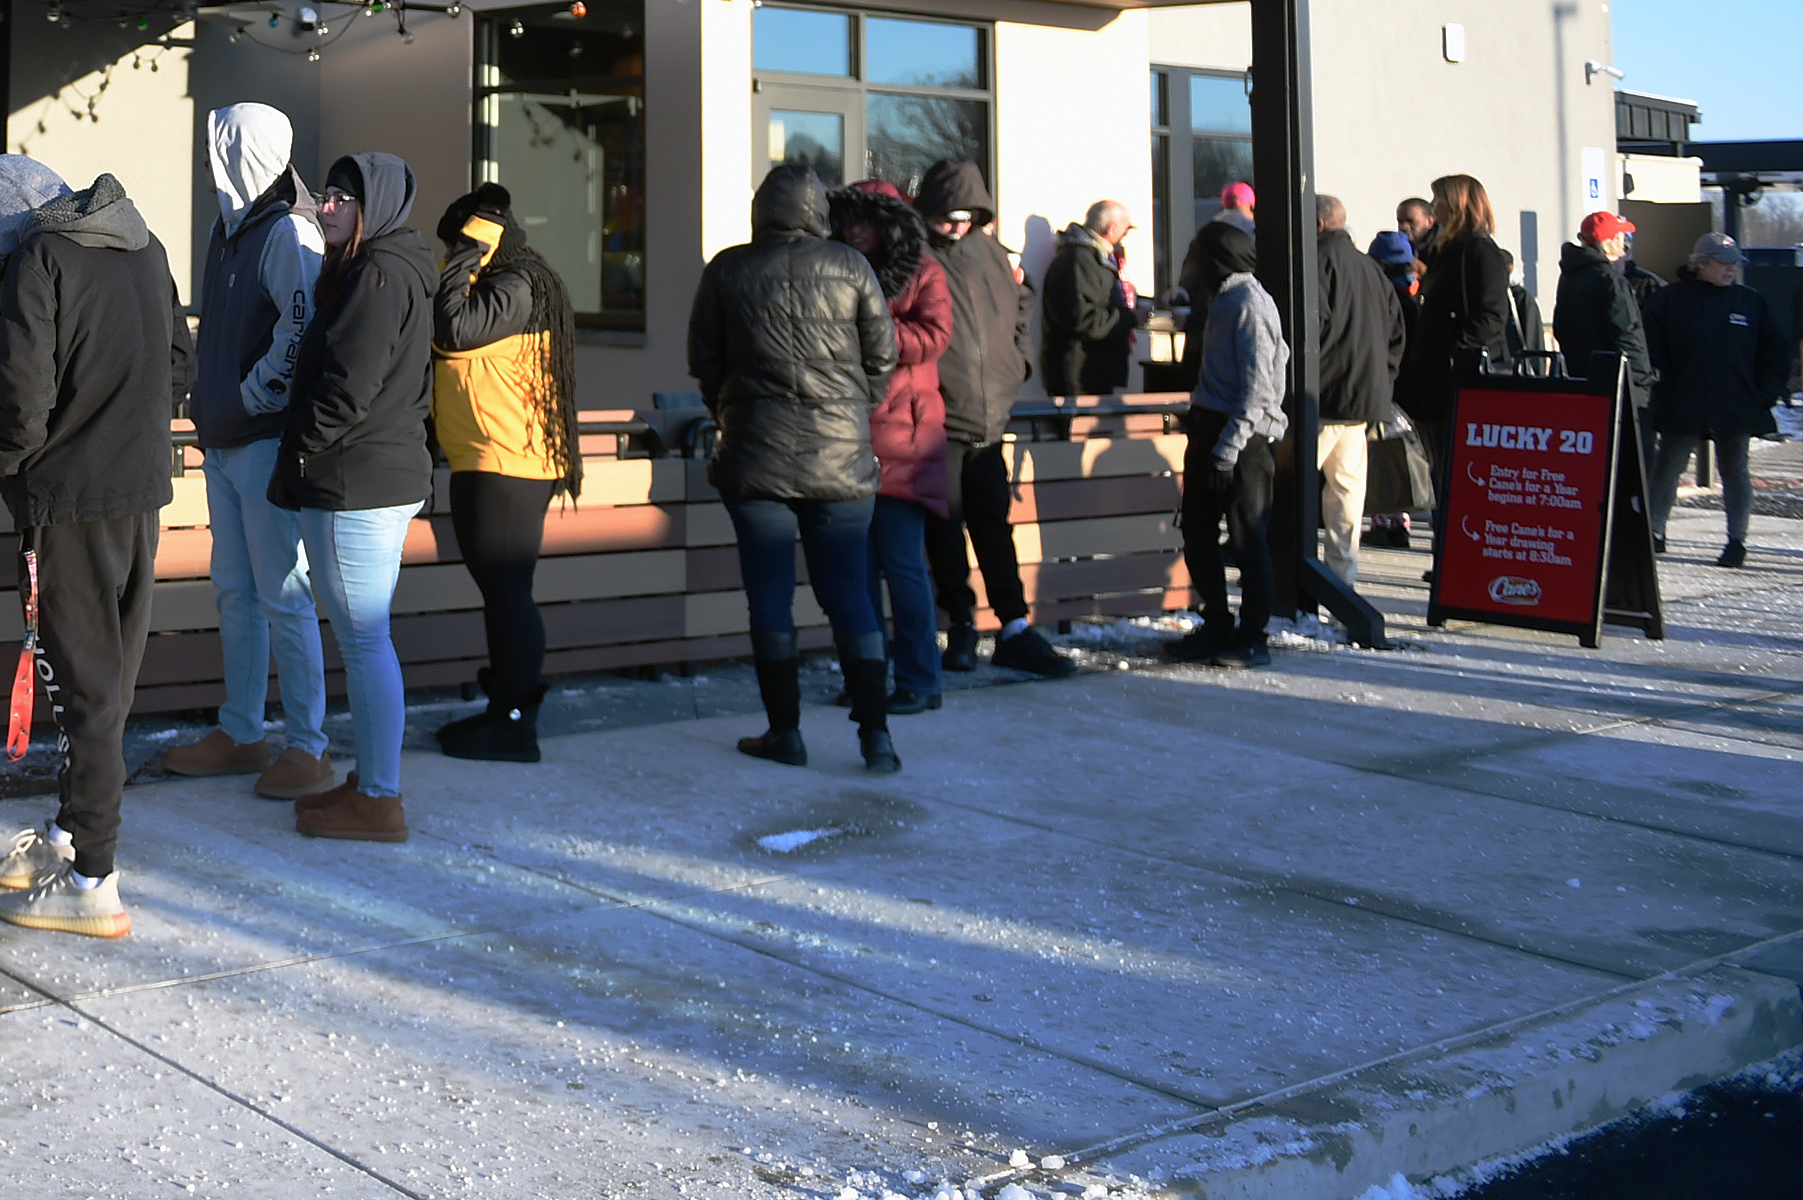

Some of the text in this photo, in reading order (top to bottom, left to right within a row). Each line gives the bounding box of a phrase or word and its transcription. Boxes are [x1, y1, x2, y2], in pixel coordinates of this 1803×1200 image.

[1466, 422, 1593, 455] LUCKY 20
[1490, 464, 1565, 482] Entry for Free
[1489, 477, 1579, 496] Cane's for a Year
[1487, 489, 1582, 509] begins at 7:00am
[1484, 519, 1575, 540] Free Cane's for a
[1484, 532, 1555, 554] Year drawing
[1482, 547, 1573, 566] starts at 8:30am
